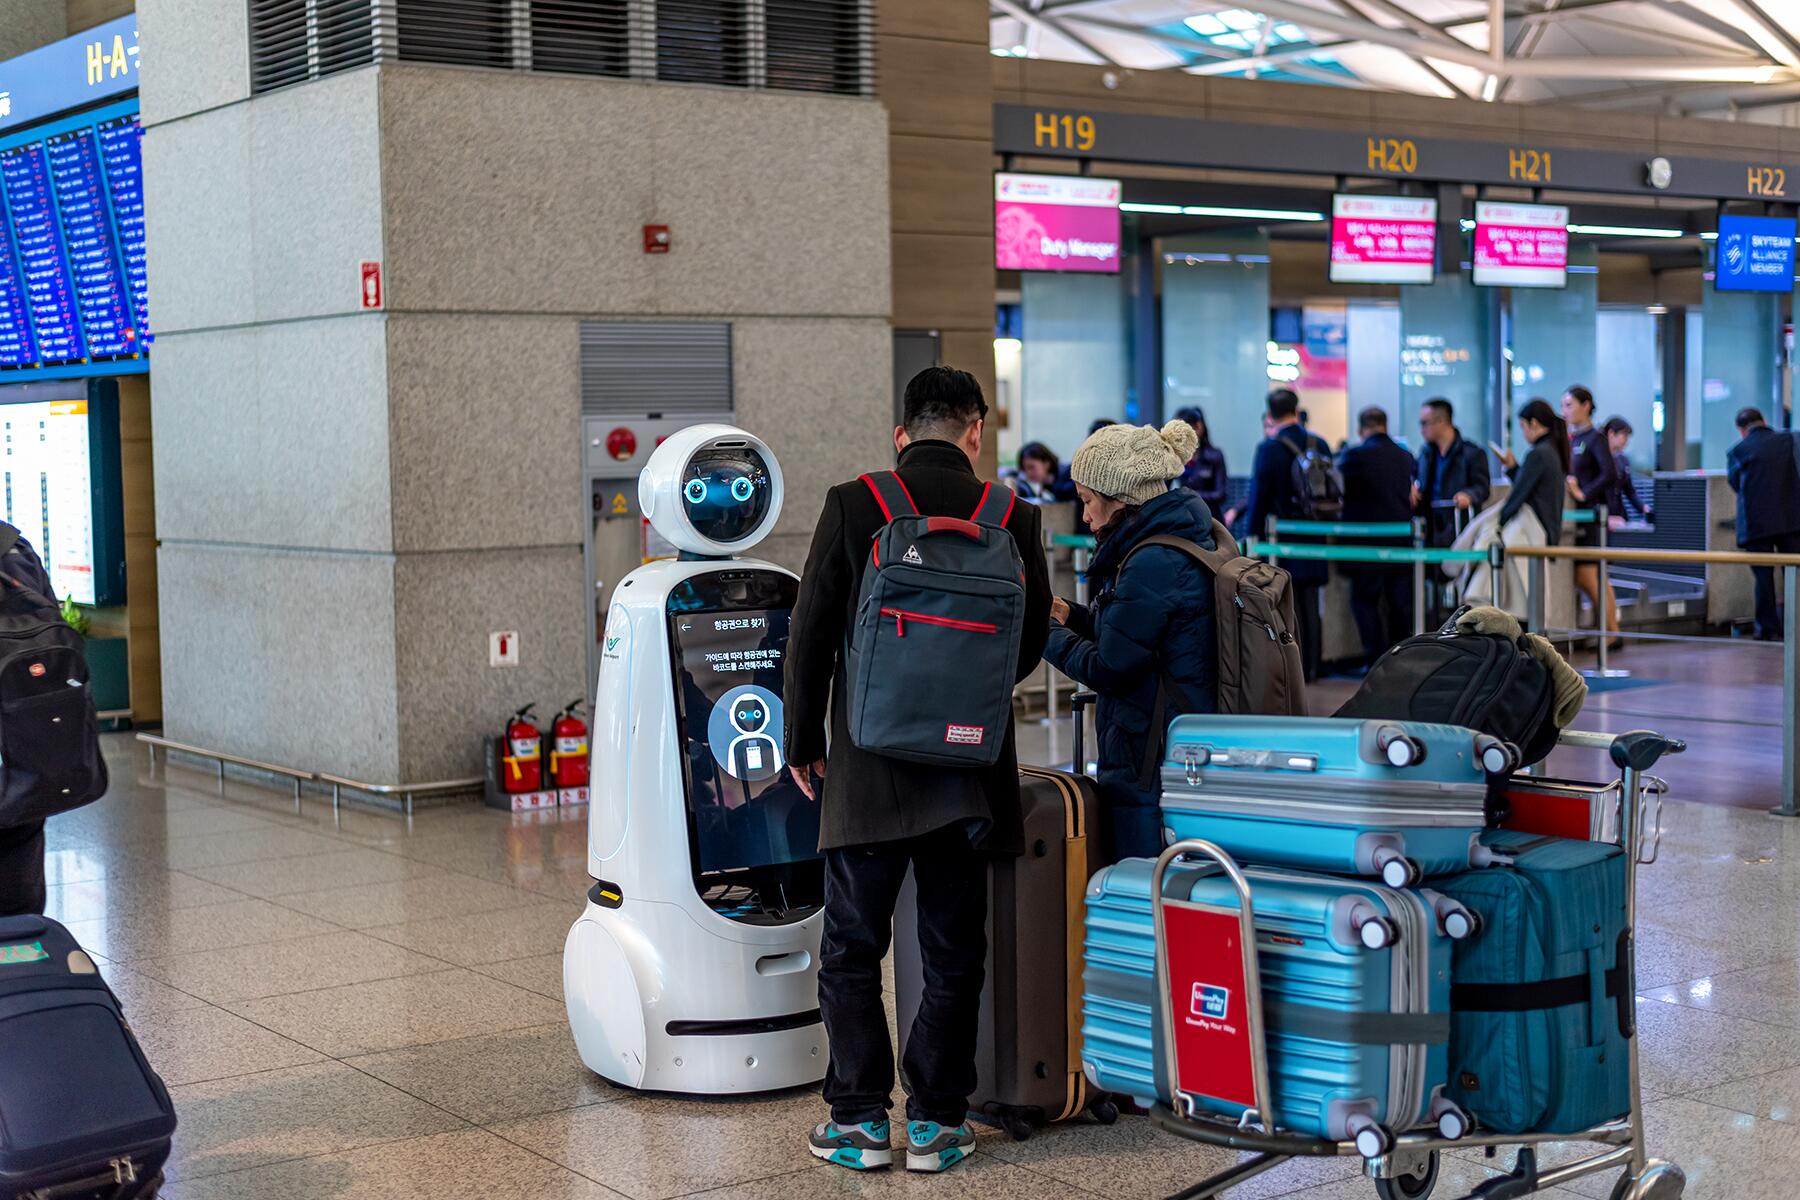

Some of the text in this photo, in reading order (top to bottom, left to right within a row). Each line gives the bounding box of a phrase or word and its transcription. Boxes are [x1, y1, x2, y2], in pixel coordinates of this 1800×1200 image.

[1034, 111, 1096, 151] H19
[1367, 136, 1418, 173] H20
[1509, 148, 1552, 182] H21
[1747, 166, 1785, 196] H22
[1751, 235, 1792, 248] SKYTEAM
[1041, 236, 1118, 261] Duty Manager
[1752, 249, 1788, 261] ALLIANCE
[1750, 263, 1784, 273] MEMBER
[714, 618, 766, 631] 항공권으로 찾기
[705, 653, 729, 662] 가이드에
[730, 652, 743, 661] 따라
[743, 650, 768, 660] 항공권에
[712, 662, 737, 672] 바코드를
